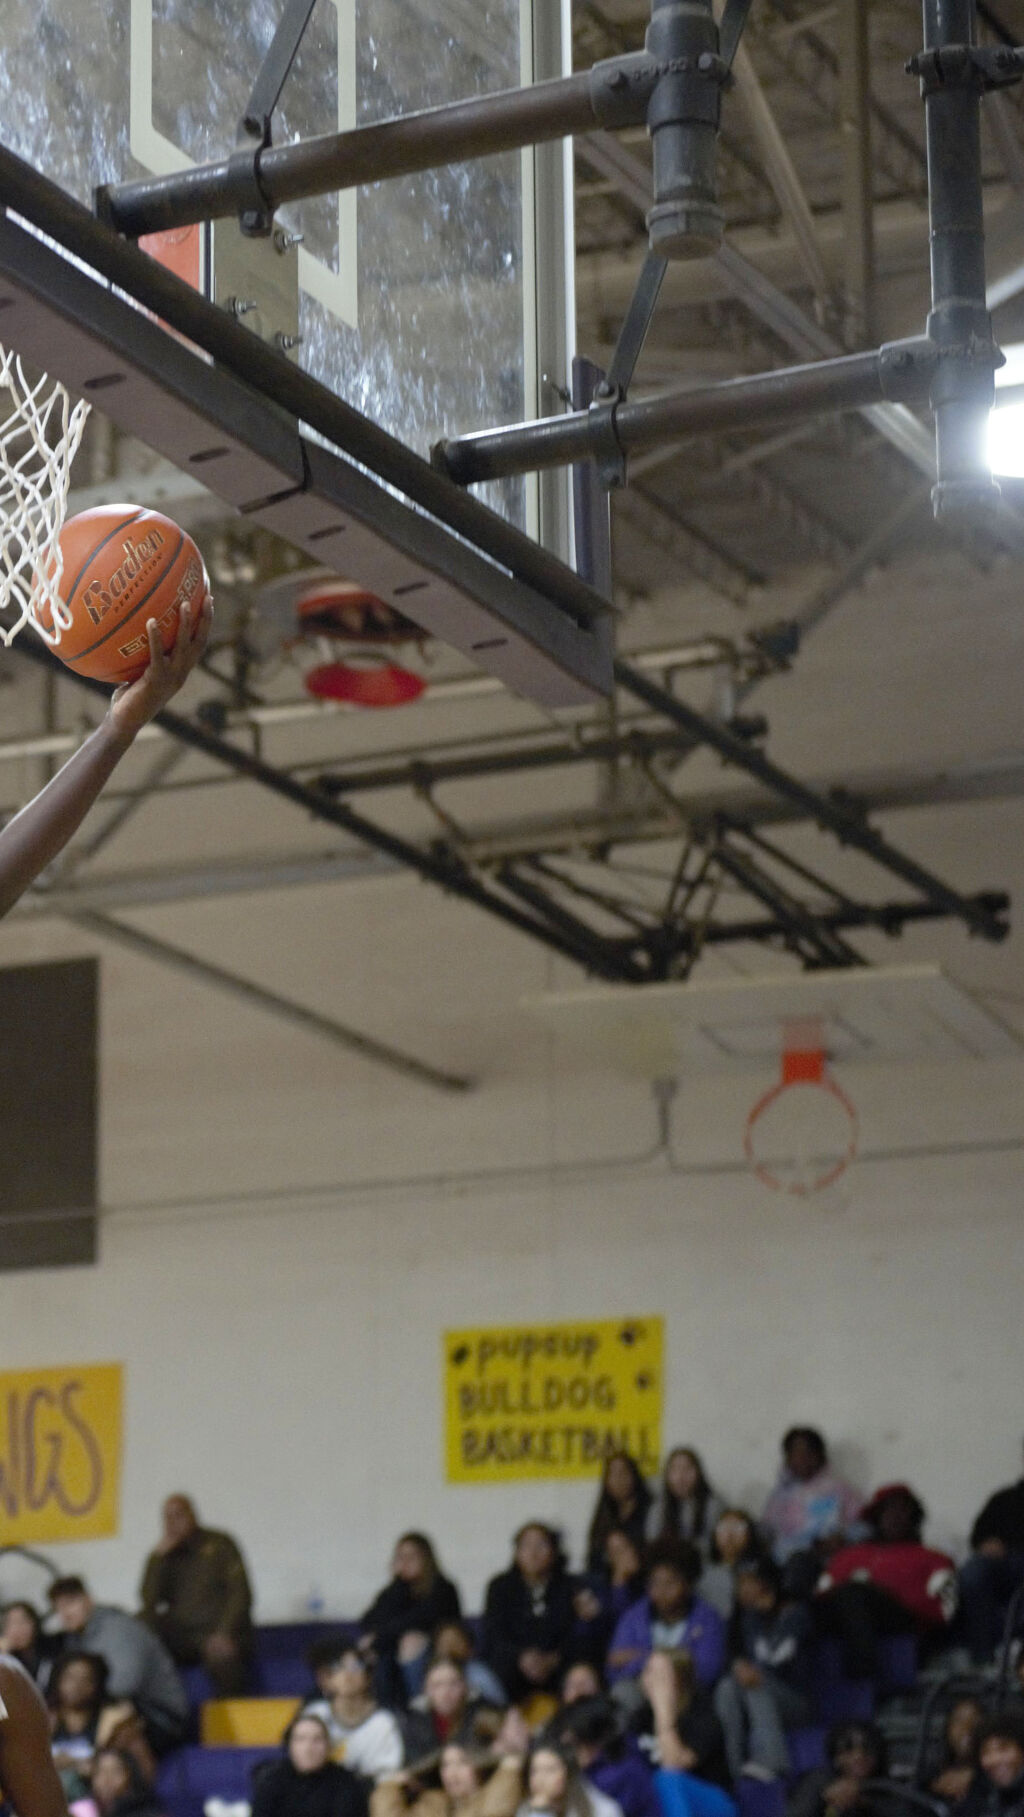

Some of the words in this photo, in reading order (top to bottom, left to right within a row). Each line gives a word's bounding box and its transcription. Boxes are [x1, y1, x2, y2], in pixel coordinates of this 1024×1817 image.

[83, 529, 164, 625] Baden
[458, 1374, 617, 1421] BULLDOG
[460, 1424, 660, 1468] BASKETBALL
